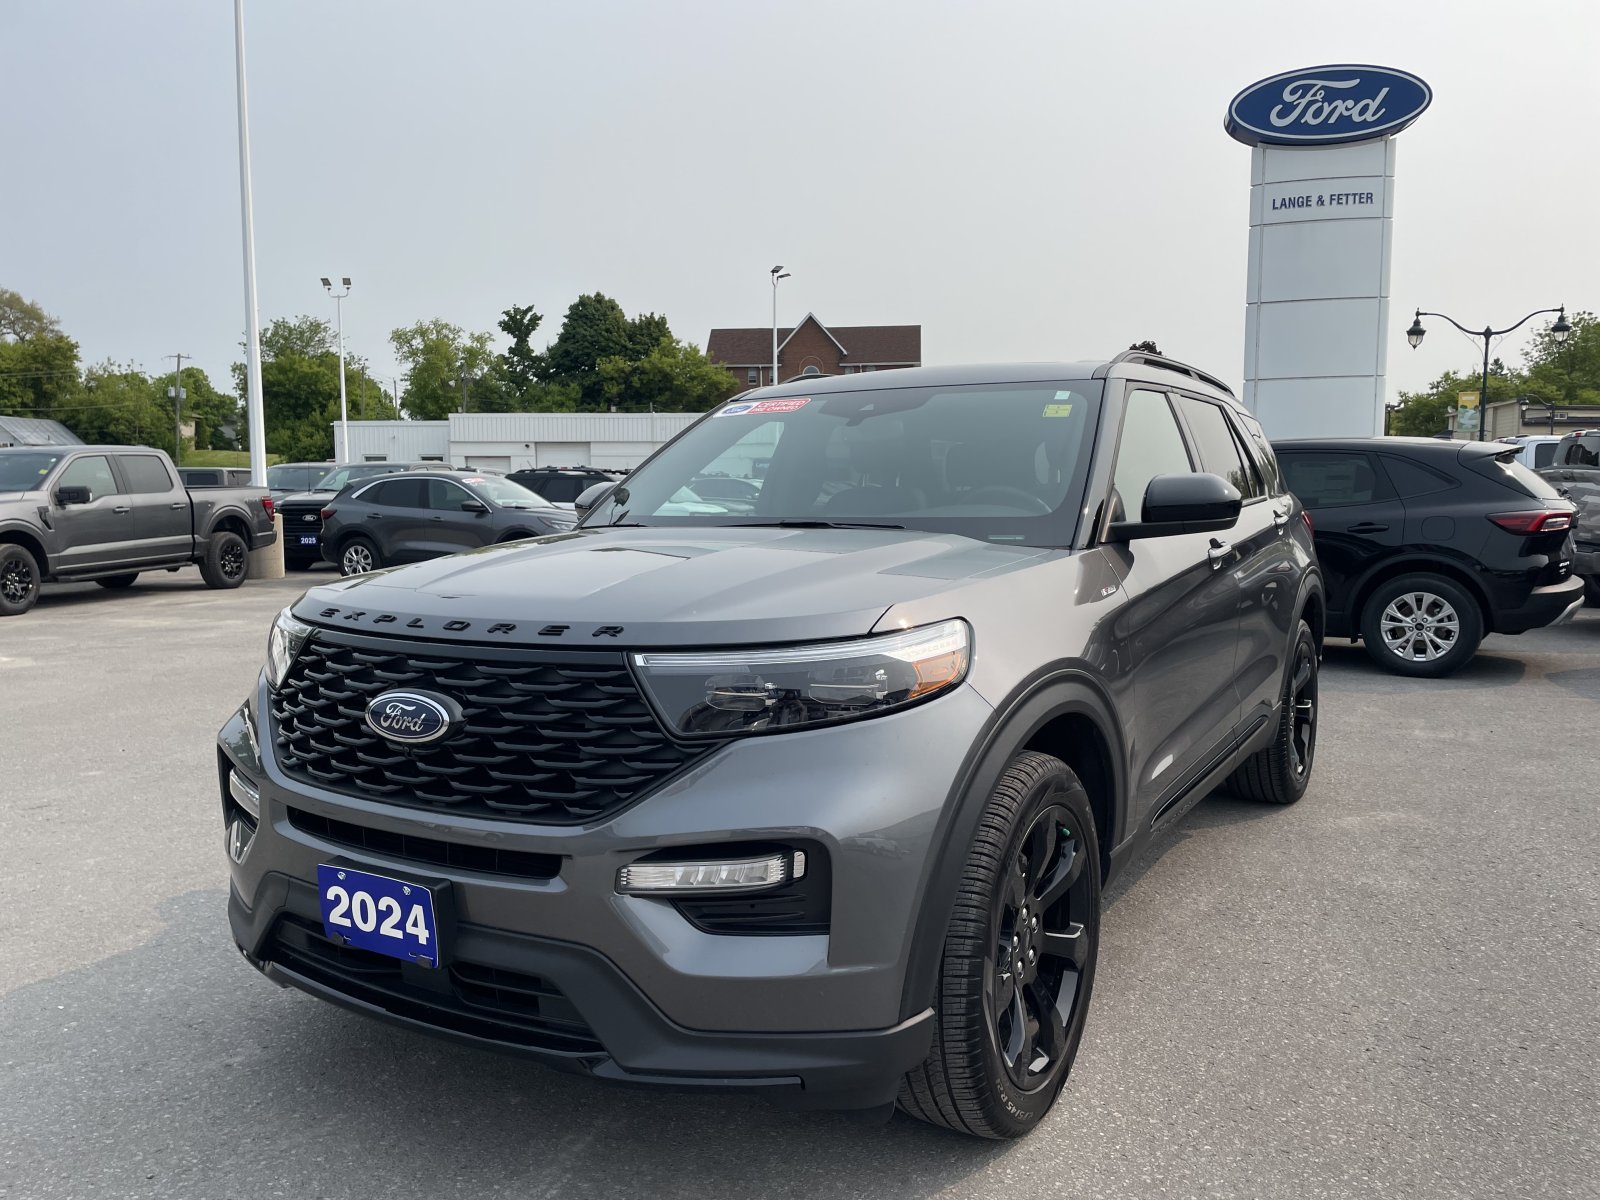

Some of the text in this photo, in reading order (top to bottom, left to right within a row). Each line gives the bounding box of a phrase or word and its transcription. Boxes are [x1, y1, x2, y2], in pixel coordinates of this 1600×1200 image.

[1269, 78, 1390, 127] Ford
[1272, 192, 1374, 210] LANGE & FETTER
[319, 607, 625, 638] EXPLORER
[380, 702, 425, 733] Ford
[326, 885, 430, 946] 2024
